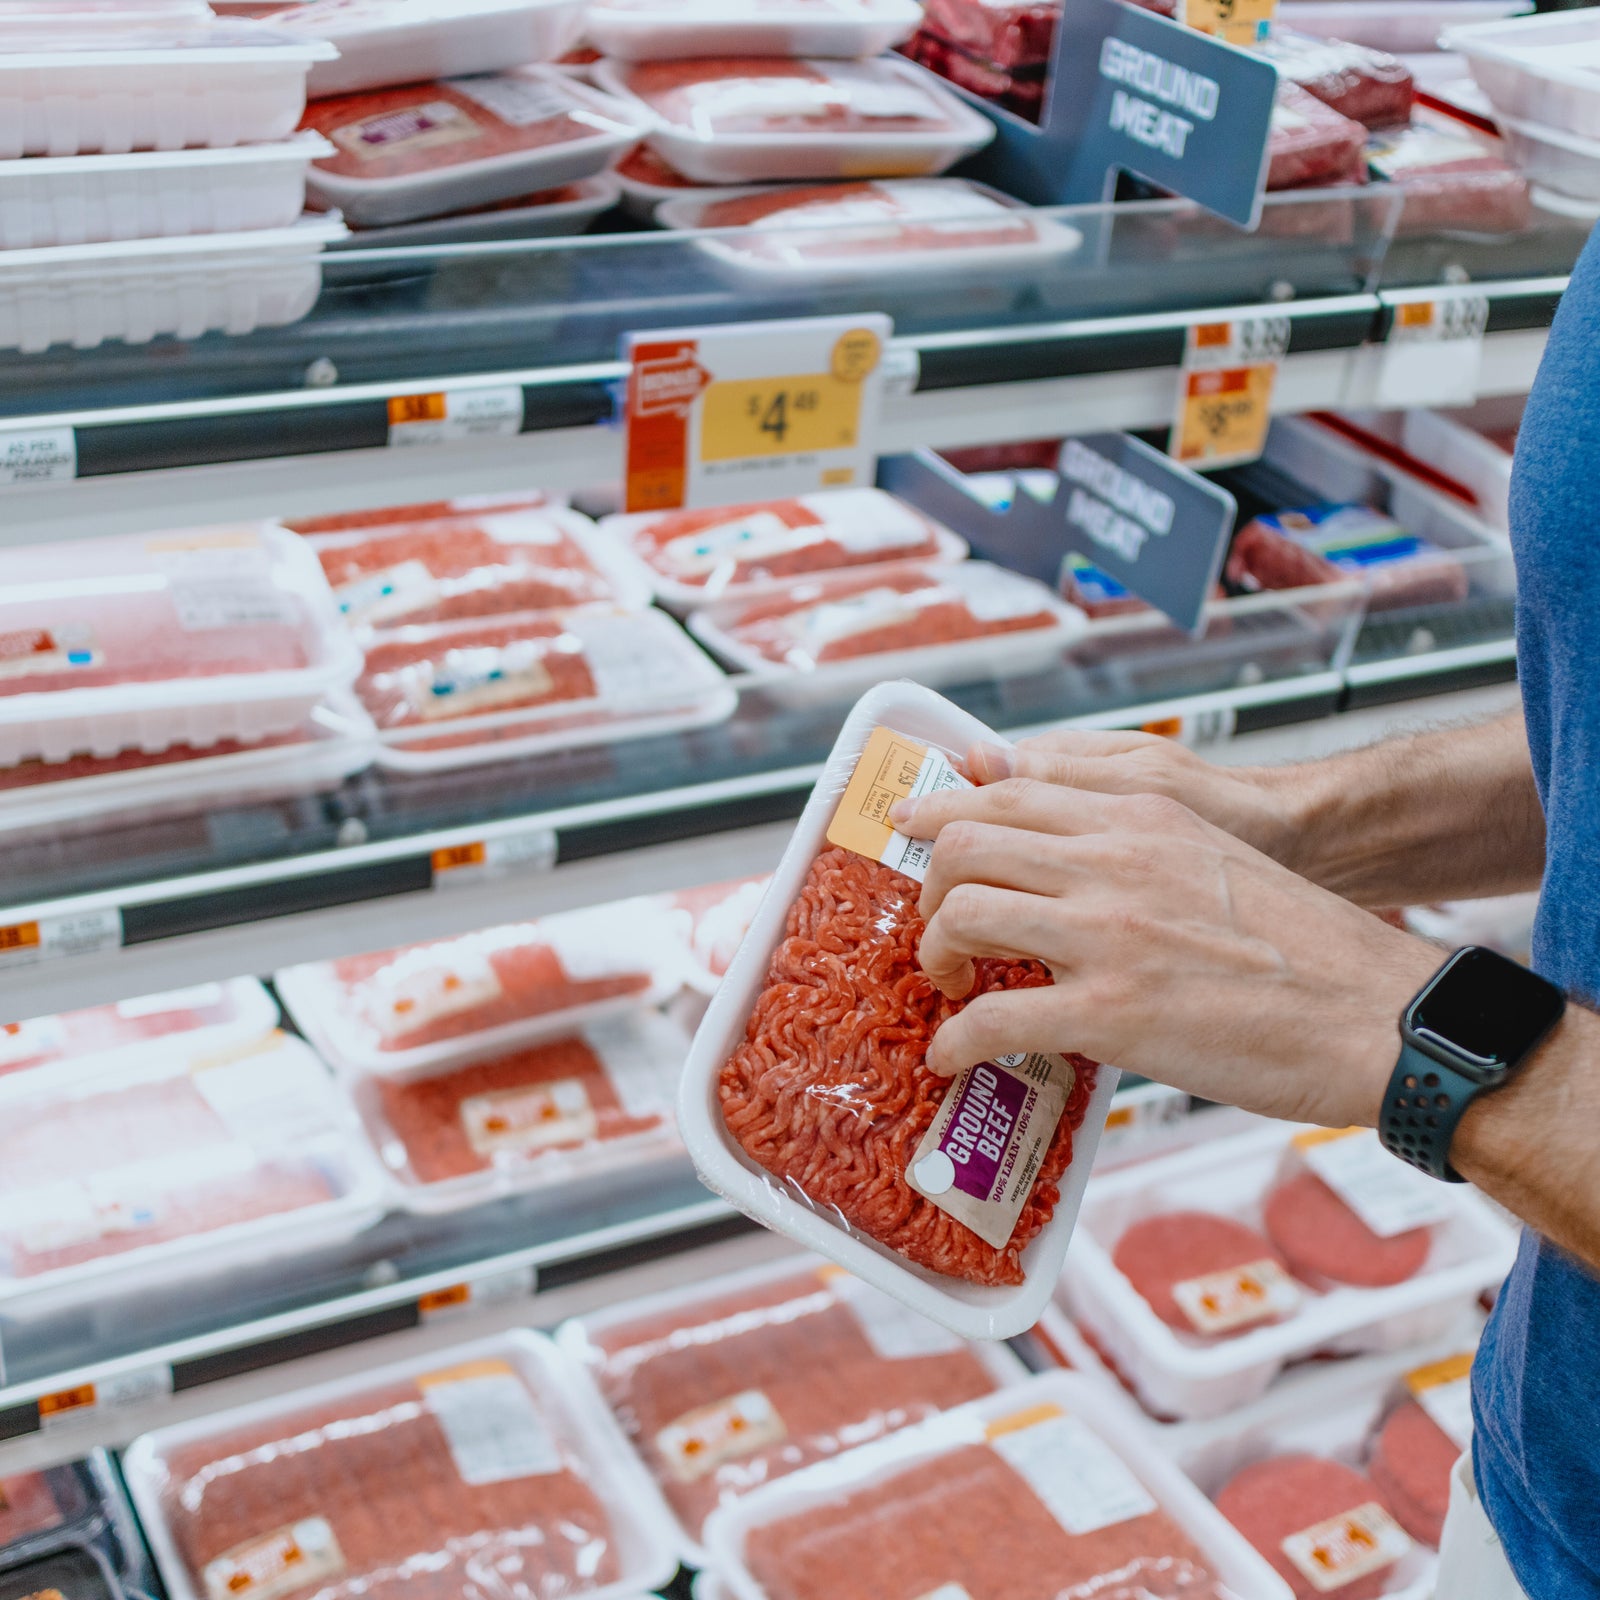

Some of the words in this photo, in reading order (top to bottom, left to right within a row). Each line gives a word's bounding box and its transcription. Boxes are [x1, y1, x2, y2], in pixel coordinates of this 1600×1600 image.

[1100, 36, 1219, 121] GROUND
[1108, 89, 1194, 160] MEAT
[9, 441, 25, 454] AS
[30, 439, 57, 451] PER
[1061, 439, 1175, 536] GROUND
[1067, 488, 1149, 563] MEAT
[898, 760, 921, 786] $5.07
[909, 851, 921, 867] 1.13
[938, 1118, 951, 1139] ALL
[948, 1066, 972, 1116] NATURAL
[945, 1066, 999, 1166] GROUND
[977, 1097, 1014, 1163] BEEF
[992, 1177, 1008, 1203] 90%
[1002, 1141, 1021, 1178] LEAN
[1017, 1112, 1031, 1136] 10%
[1024, 1087, 1039, 1113] FAT
[1010, 1184, 1021, 1203] KEEP
[1017, 1136, 1042, 1185] REFRIGERATED
